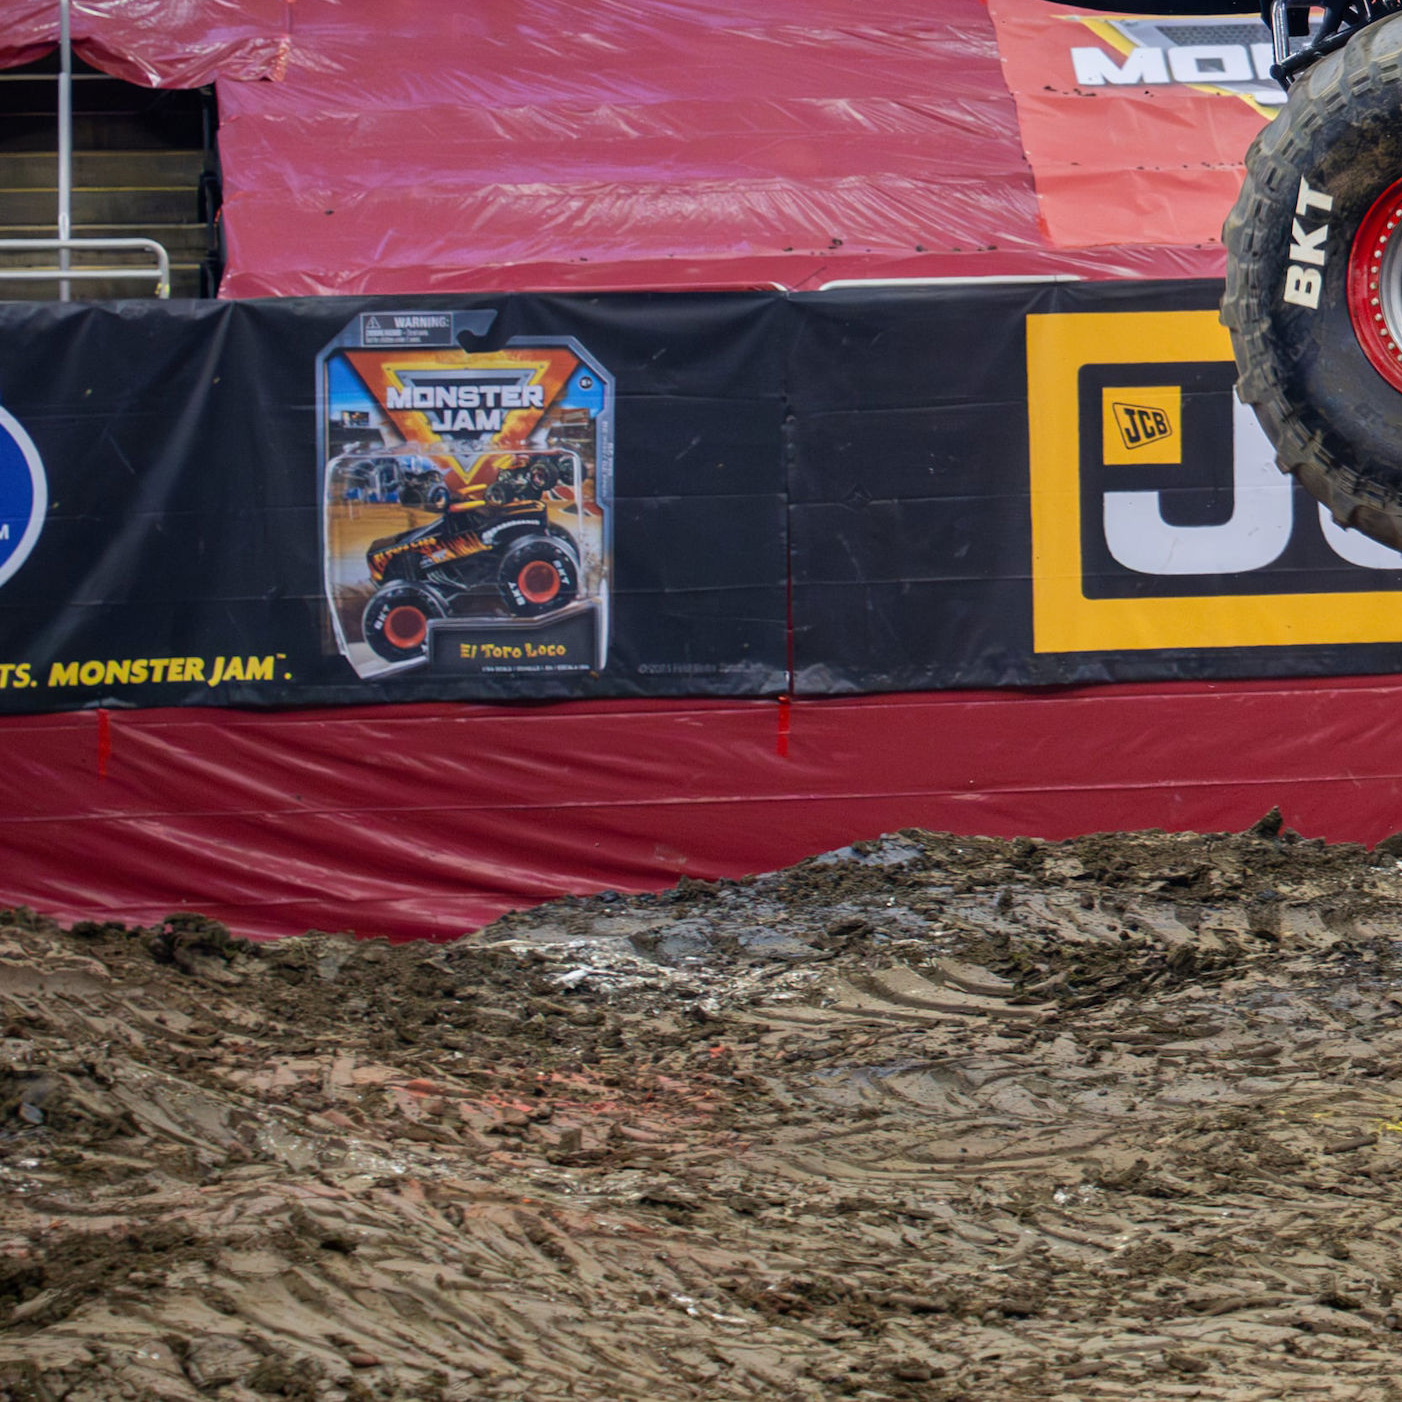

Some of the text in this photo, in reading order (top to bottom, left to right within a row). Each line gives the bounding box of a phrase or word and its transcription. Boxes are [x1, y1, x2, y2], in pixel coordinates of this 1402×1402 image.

[1284, 174, 1333, 310] BKT
[394, 316, 450, 329] WARNING:
[386, 385, 544, 410] MONSTER
[433, 409, 502, 432] JAM
[1123, 408, 1168, 443] JCB
[480, 644, 521, 660] Toro
[525, 642, 566, 657] Loco
[0, 663, 38, 689] TS.
[48, 657, 206, 687] MONSTER
